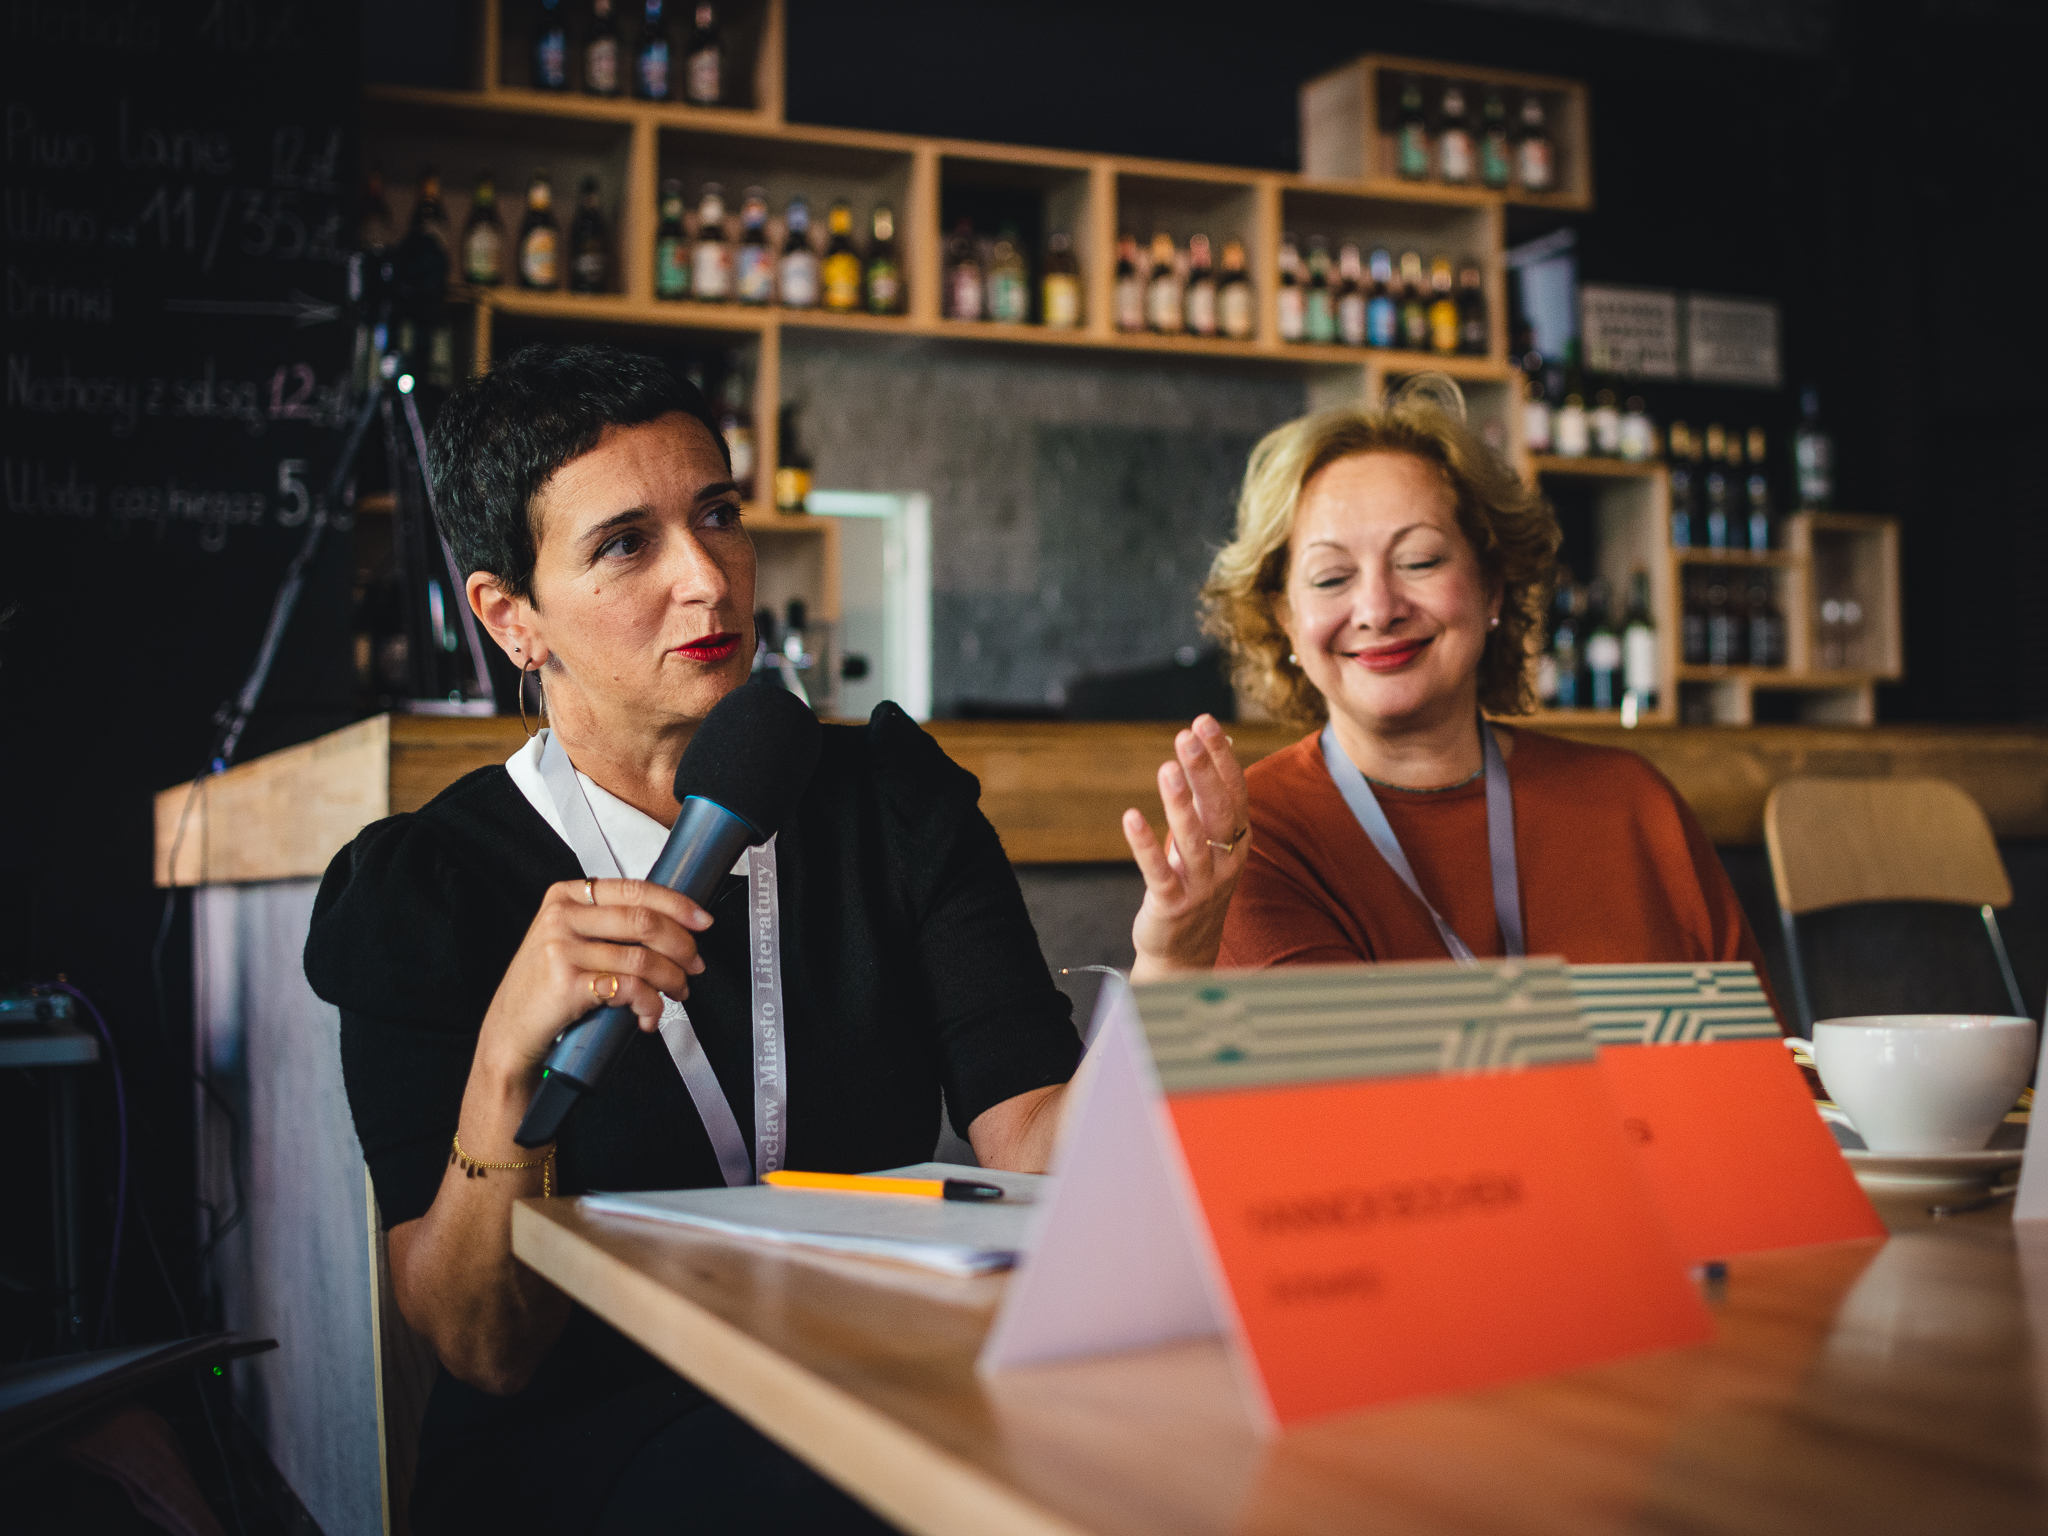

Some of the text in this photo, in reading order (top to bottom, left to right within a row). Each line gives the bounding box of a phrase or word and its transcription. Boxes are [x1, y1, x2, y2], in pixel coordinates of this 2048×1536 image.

[5, 102, 94, 171] Piwo
[4, 185, 97, 246] Wino
[755, 862, 775, 990] Literatury
[759, 1000, 778, 1087] Miasto
